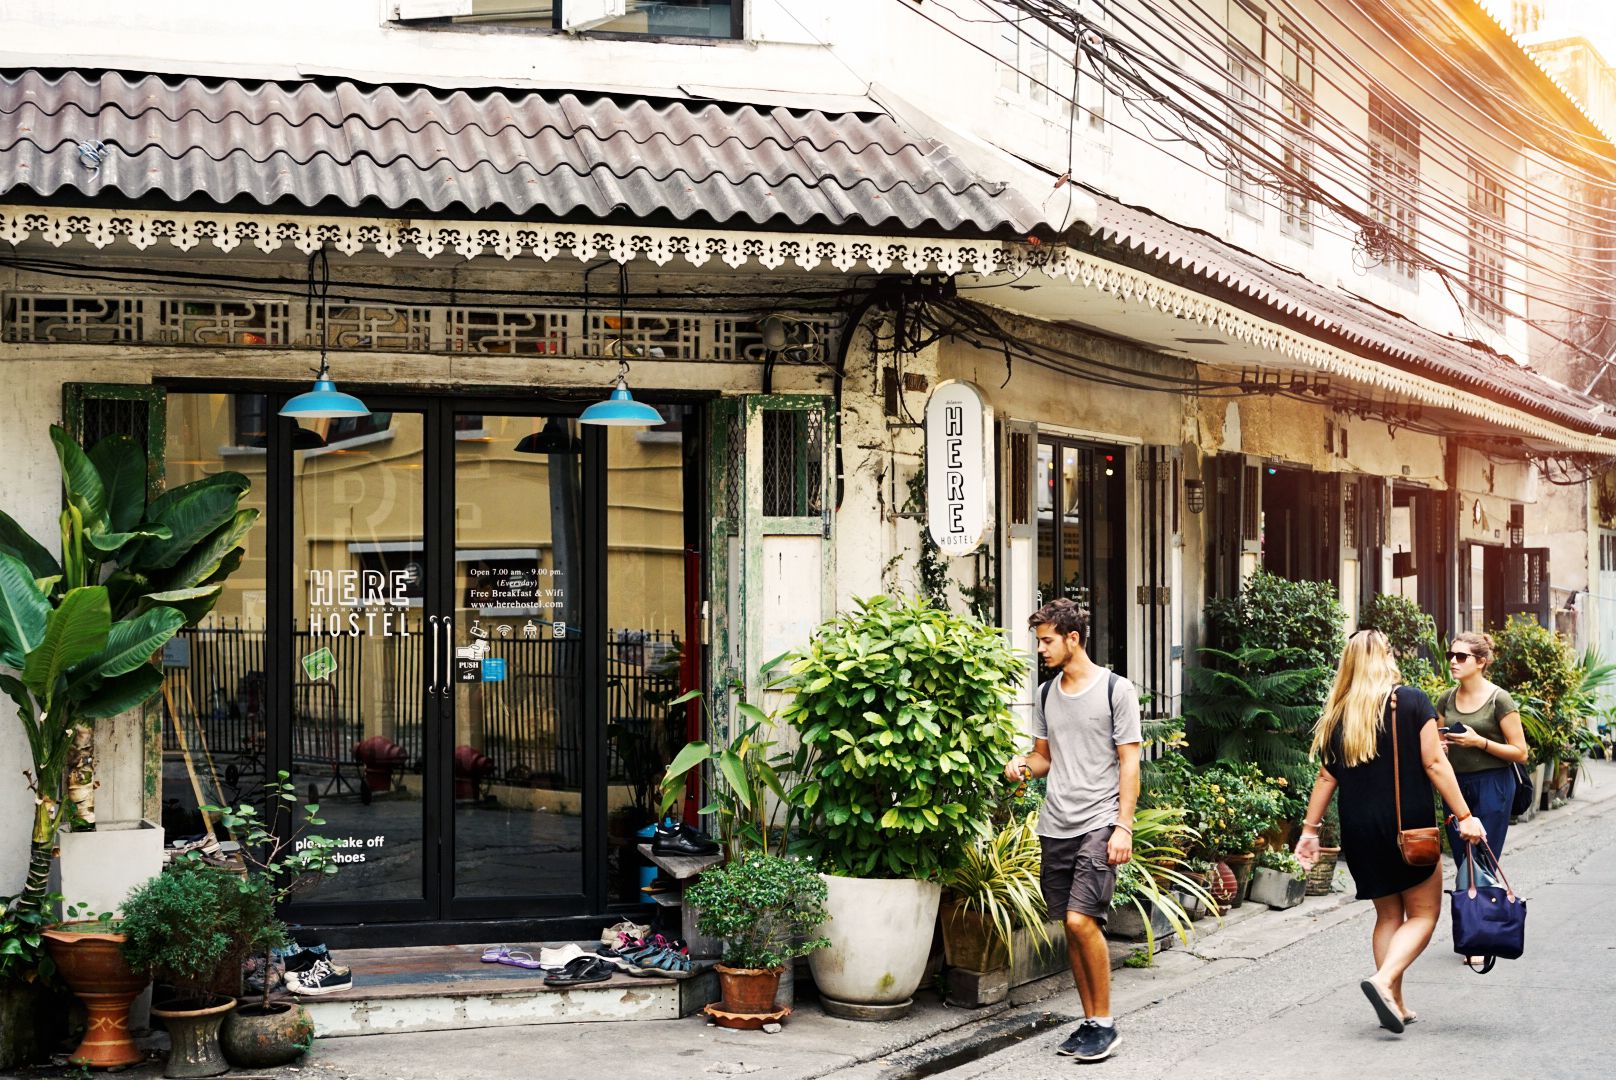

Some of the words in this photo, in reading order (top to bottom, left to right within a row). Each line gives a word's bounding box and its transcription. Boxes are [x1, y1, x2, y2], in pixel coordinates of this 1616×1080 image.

[945, 406, 965, 533] HERE
[940, 535, 974, 545] HOSTEL
[470, 568, 490, 577] Open
[492, 568, 508, 576] 7.00
[531, 568, 547, 576] 9.00
[549, 569, 564, 577] pm.
[310, 569, 410, 606] HERE
[496, 579, 538, 588] (Everyday)
[470, 589, 489, 598] Free
[492, 589, 532, 598] Breakfast
[534, 589, 542, 598] &
[545, 588, 564, 598] Wifi
[470, 600, 564, 609] www.herehostel.com
[310, 612, 410, 637] HOSTEL
[458, 661, 479, 669] PUSH
[366, 835, 385, 847] off
[331, 852, 366, 863] shoes
